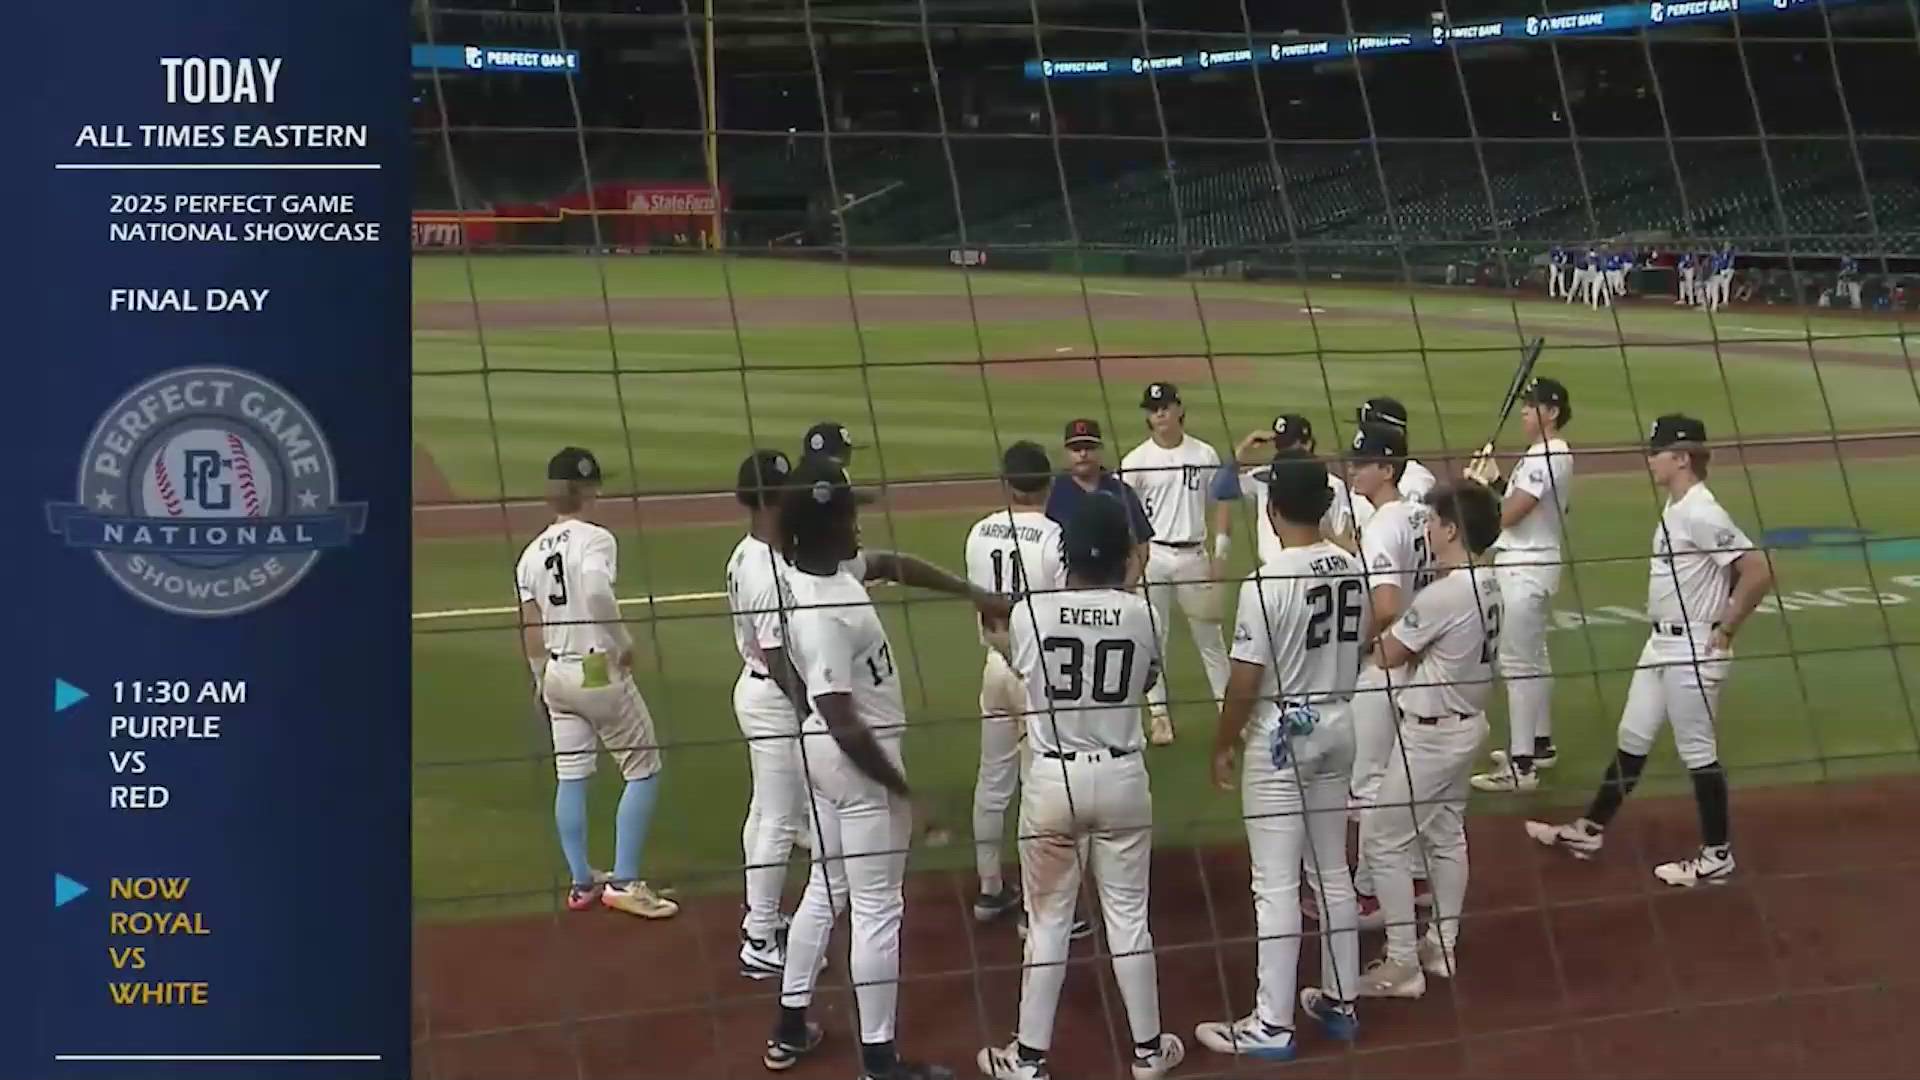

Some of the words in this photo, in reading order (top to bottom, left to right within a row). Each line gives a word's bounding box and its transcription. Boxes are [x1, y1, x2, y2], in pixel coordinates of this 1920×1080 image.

[1667, 1, 1709, 17] PERFECT
[1445, 27, 1478, 38] RFECT
[487, 51, 539, 66] PERFECT
[1310, 555, 1349, 577] HEARN
[544, 552, 568, 606] 3
[1060, 607, 1122, 627] EVERLY
[1305, 580, 1363, 650] 26
[1043, 636, 1136, 703] 30
